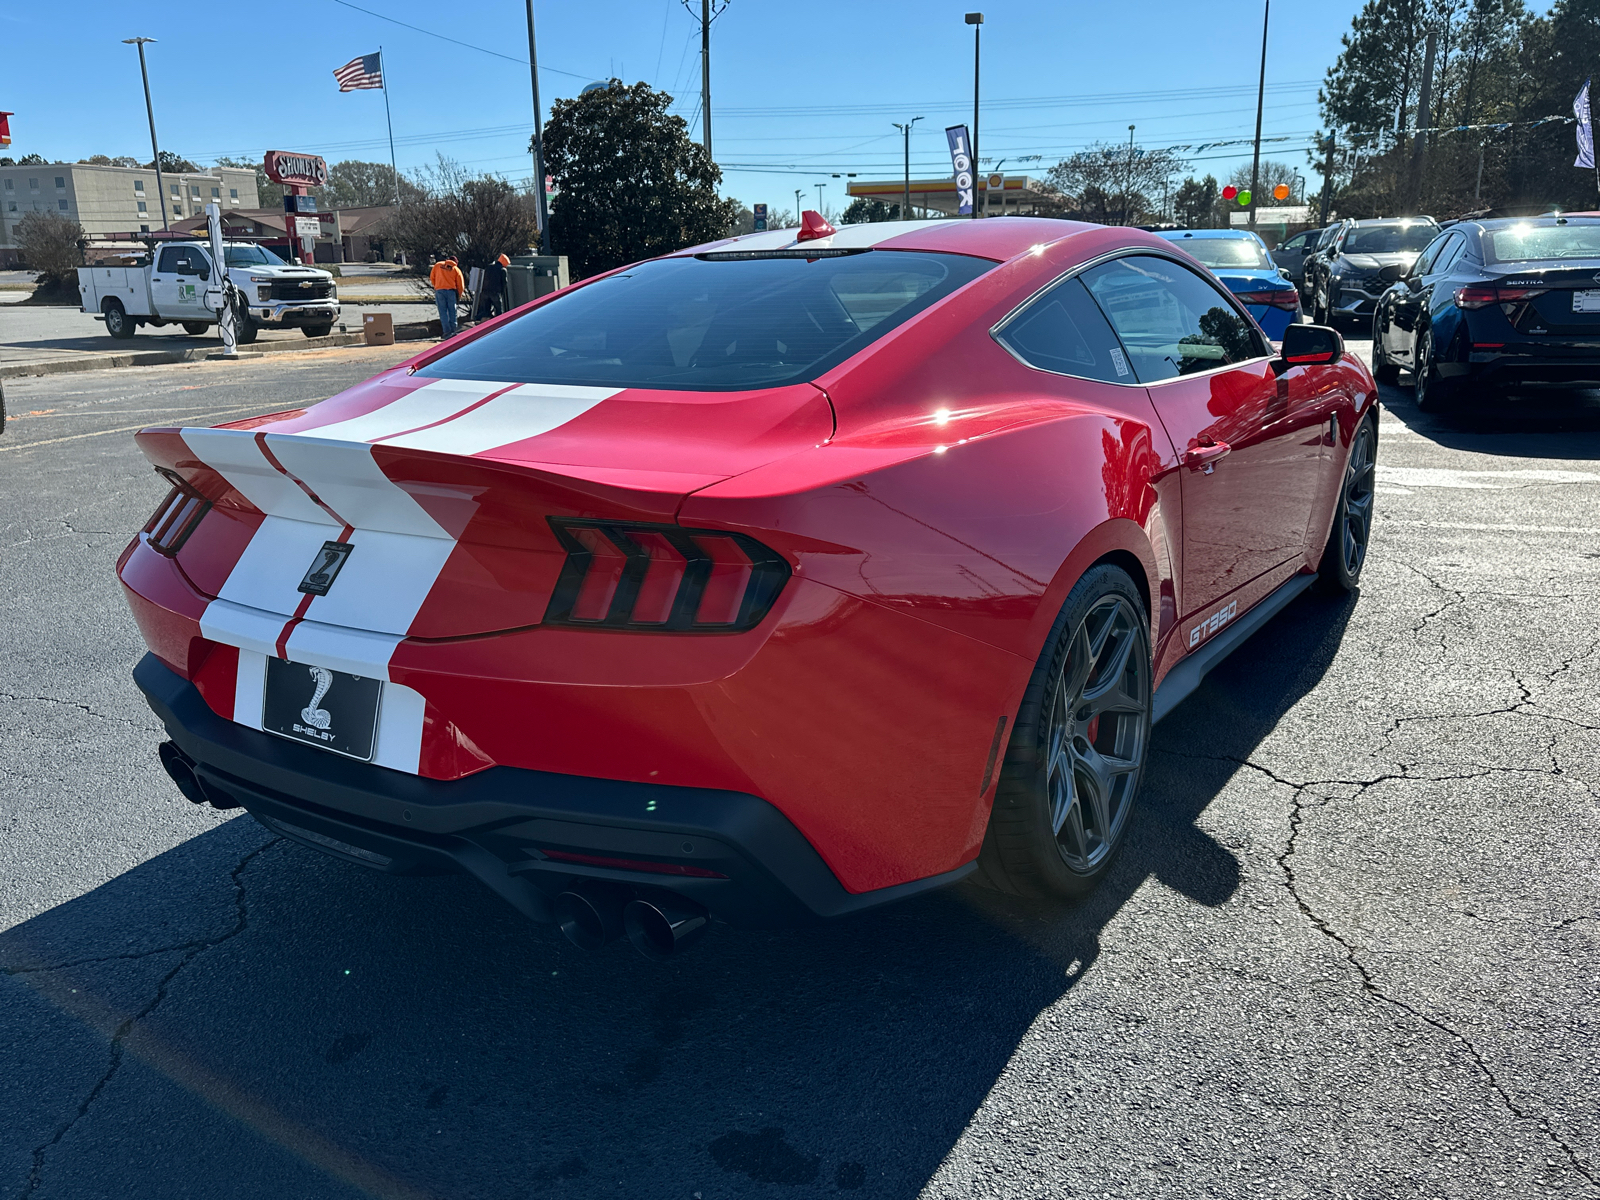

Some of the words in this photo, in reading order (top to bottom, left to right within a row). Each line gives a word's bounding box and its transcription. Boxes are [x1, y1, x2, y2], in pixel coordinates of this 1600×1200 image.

[278, 155, 326, 181] SHONEY'S
[1189, 600, 1237, 647] GT350
[1038, 628, 1069, 740] MICHELIN
[292, 723, 336, 742] SHELBY
